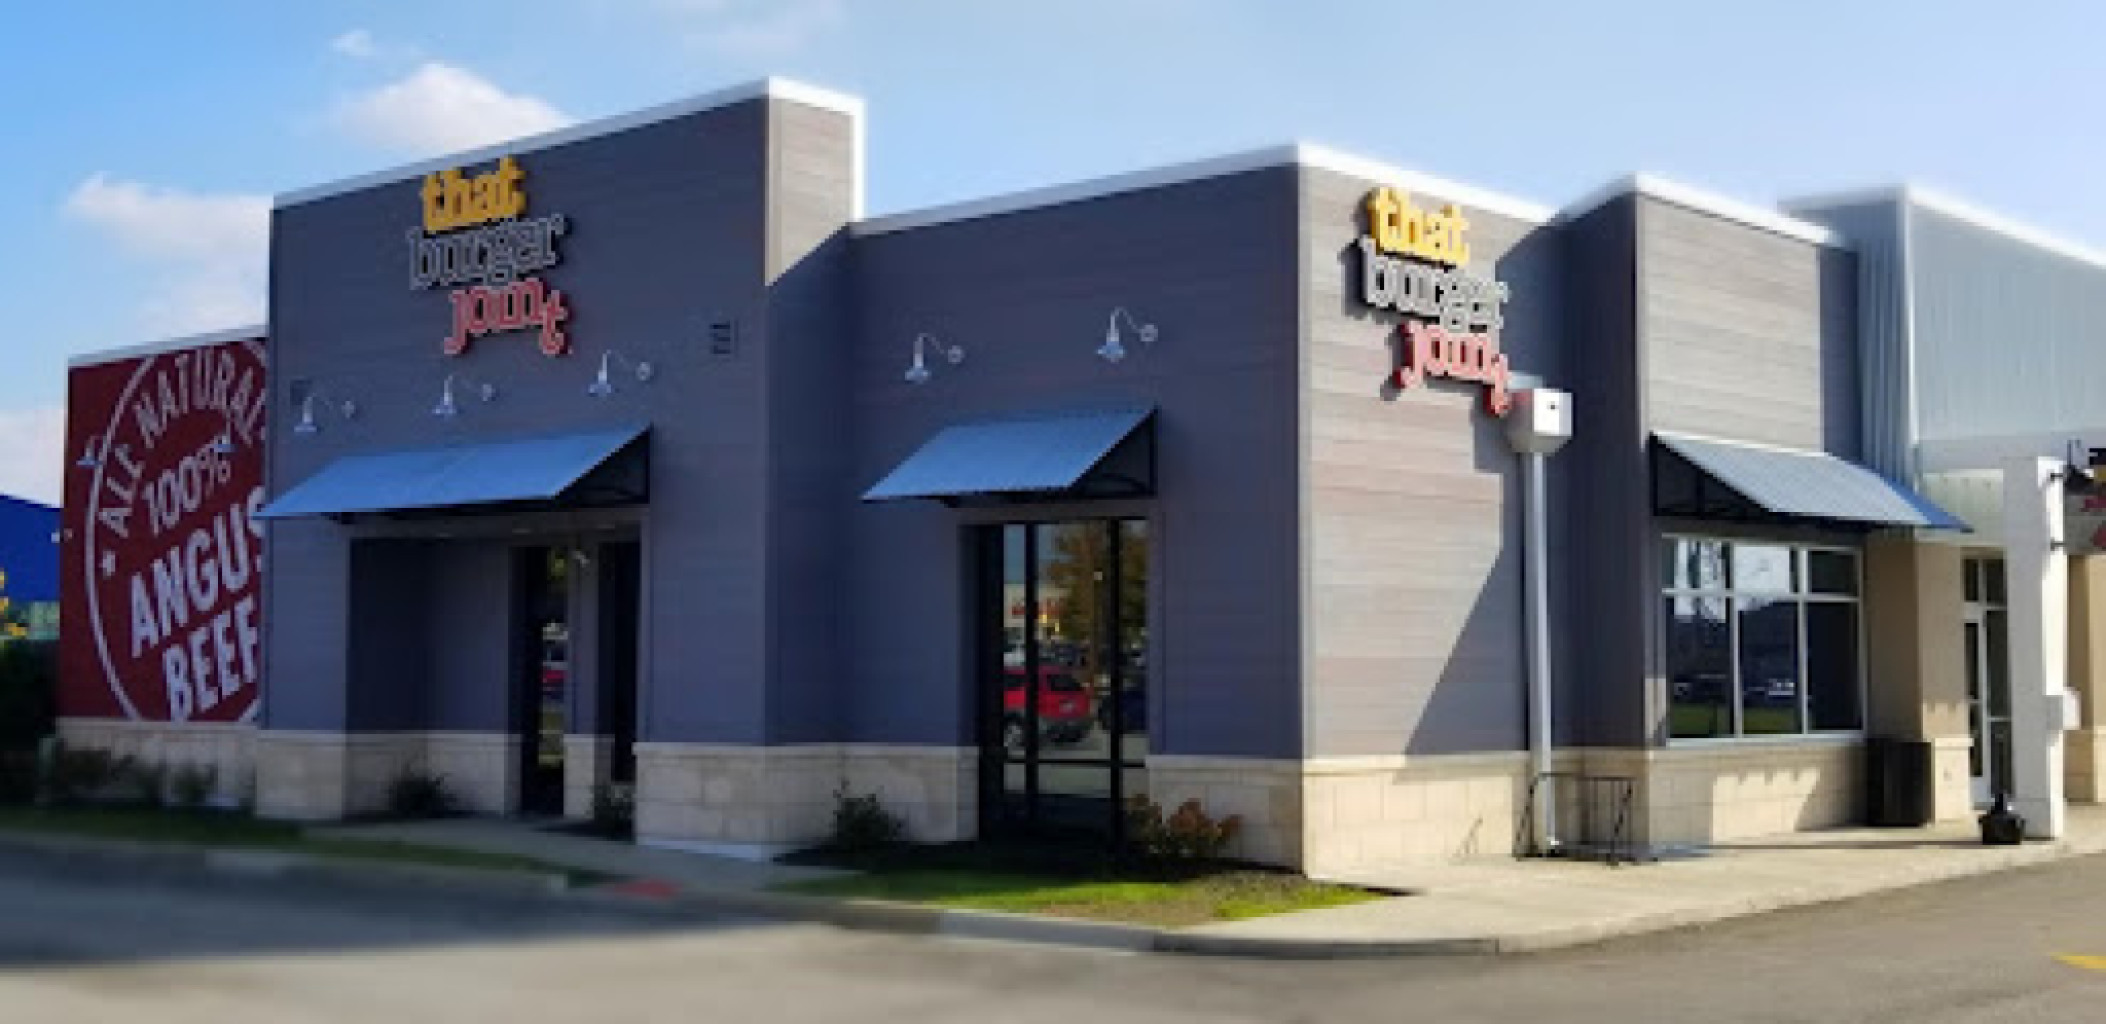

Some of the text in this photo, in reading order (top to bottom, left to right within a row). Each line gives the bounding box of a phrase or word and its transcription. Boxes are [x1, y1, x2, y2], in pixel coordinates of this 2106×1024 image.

[420, 157, 526, 234] that
[1368, 186, 1470, 266] that
[405, 213, 566, 290] burger
[1360, 234, 1510, 333] burger
[98, 444, 144, 539] ALL
[142, 434, 232, 538] 100%
[162, 594, 259, 721] BEEF
